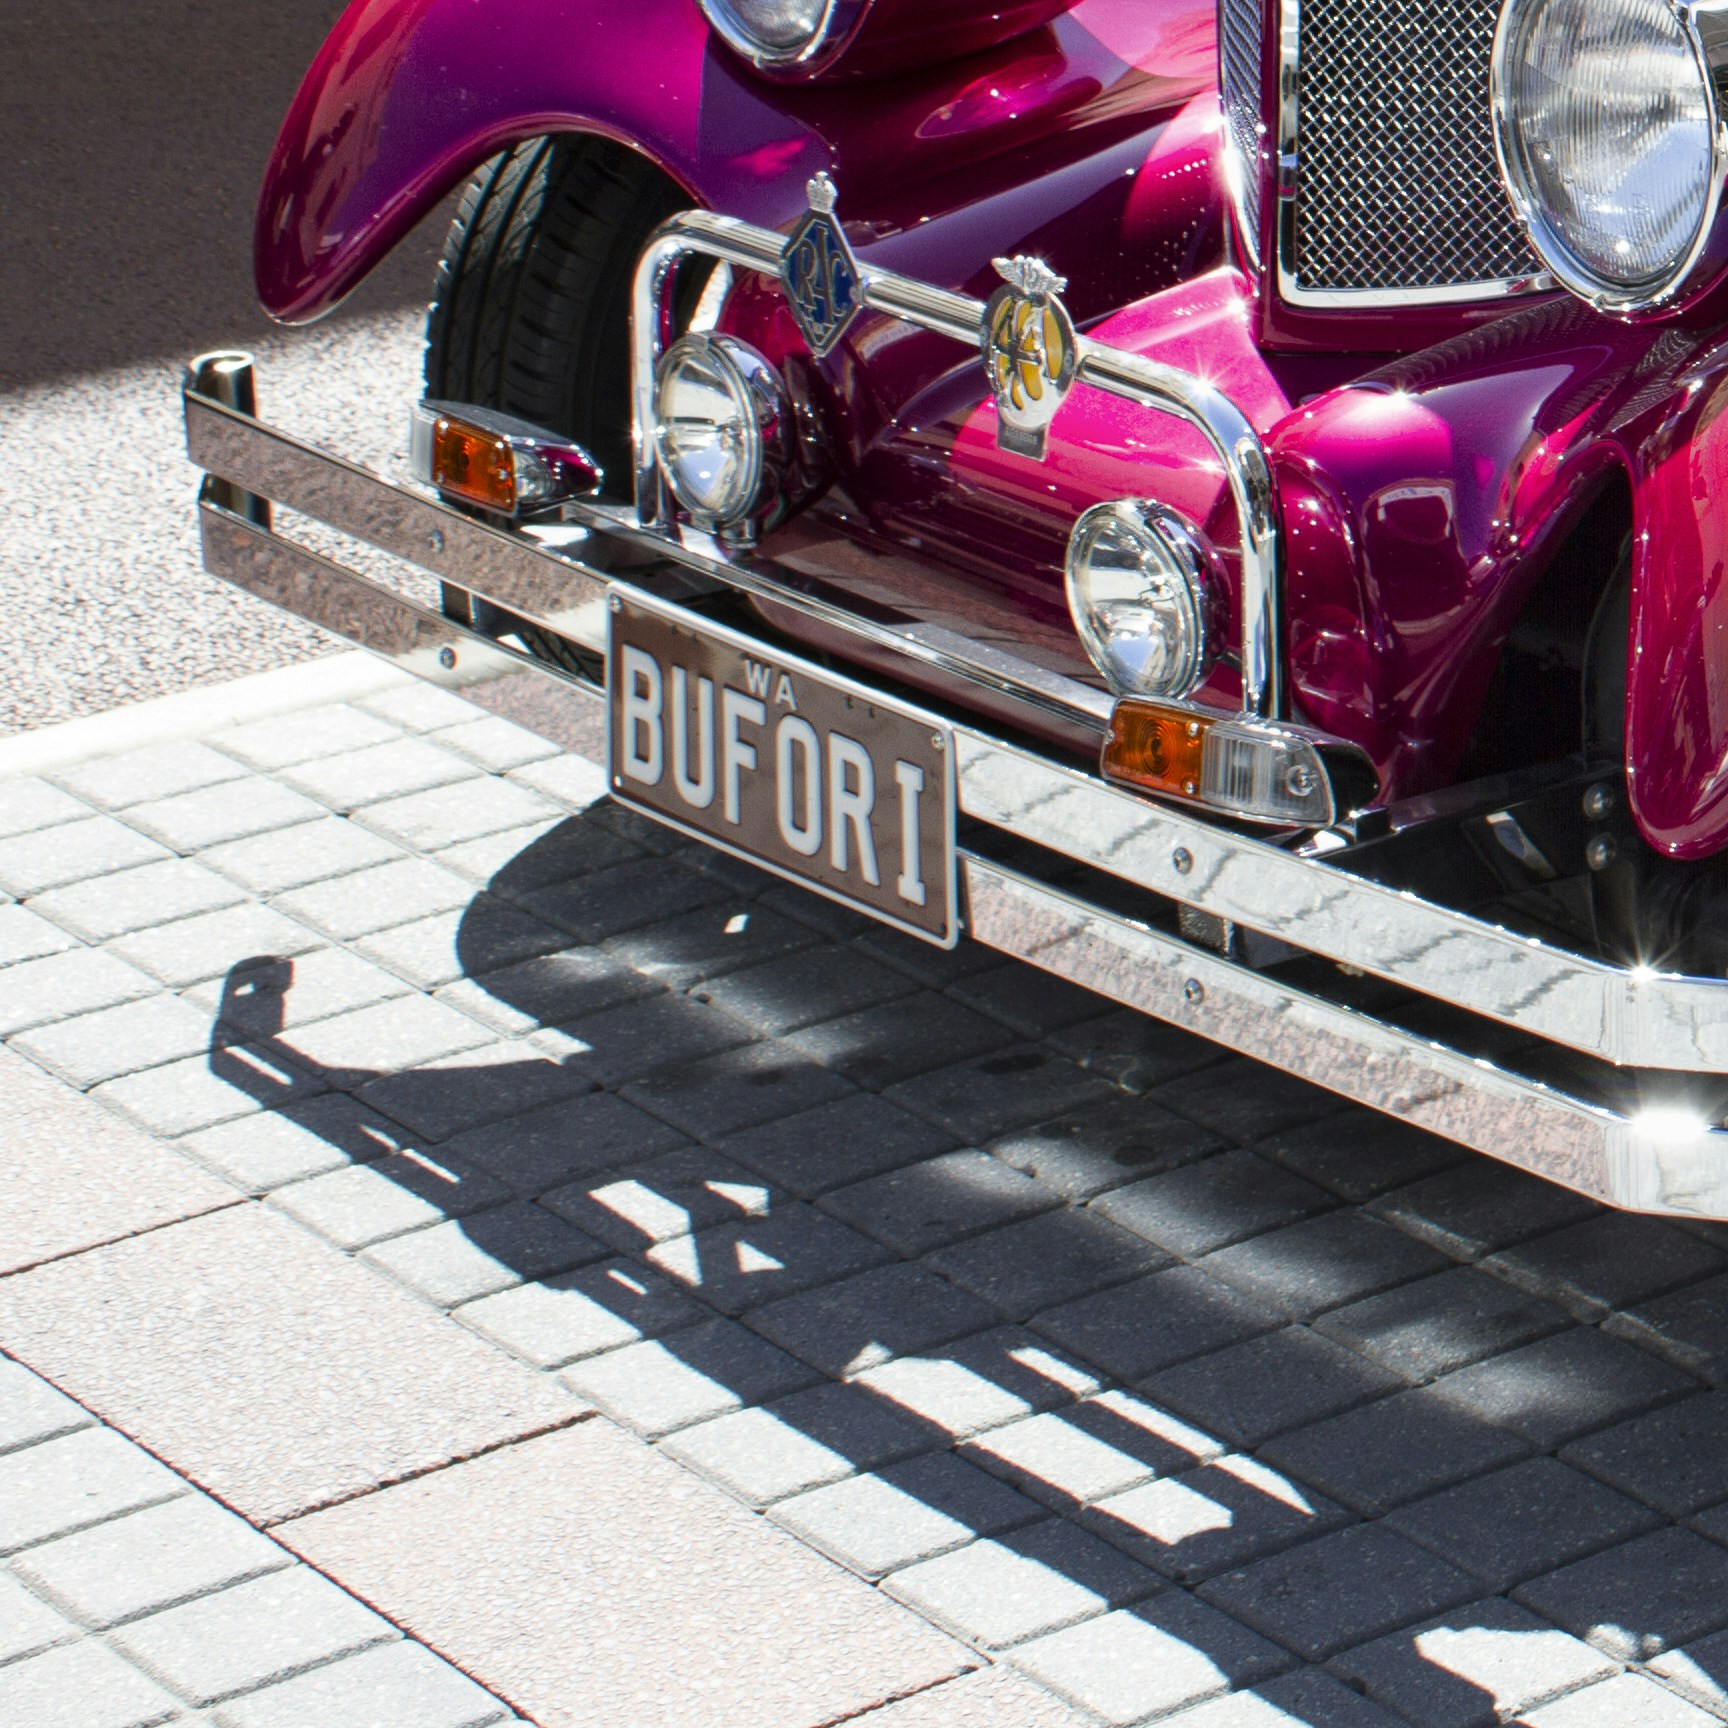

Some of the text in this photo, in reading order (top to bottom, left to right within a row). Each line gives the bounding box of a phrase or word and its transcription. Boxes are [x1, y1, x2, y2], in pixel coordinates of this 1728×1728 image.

[796, 225, 848, 326] RAC
[745, 659, 798, 710] WA
[622, 643, 926, 907] BUFORI
